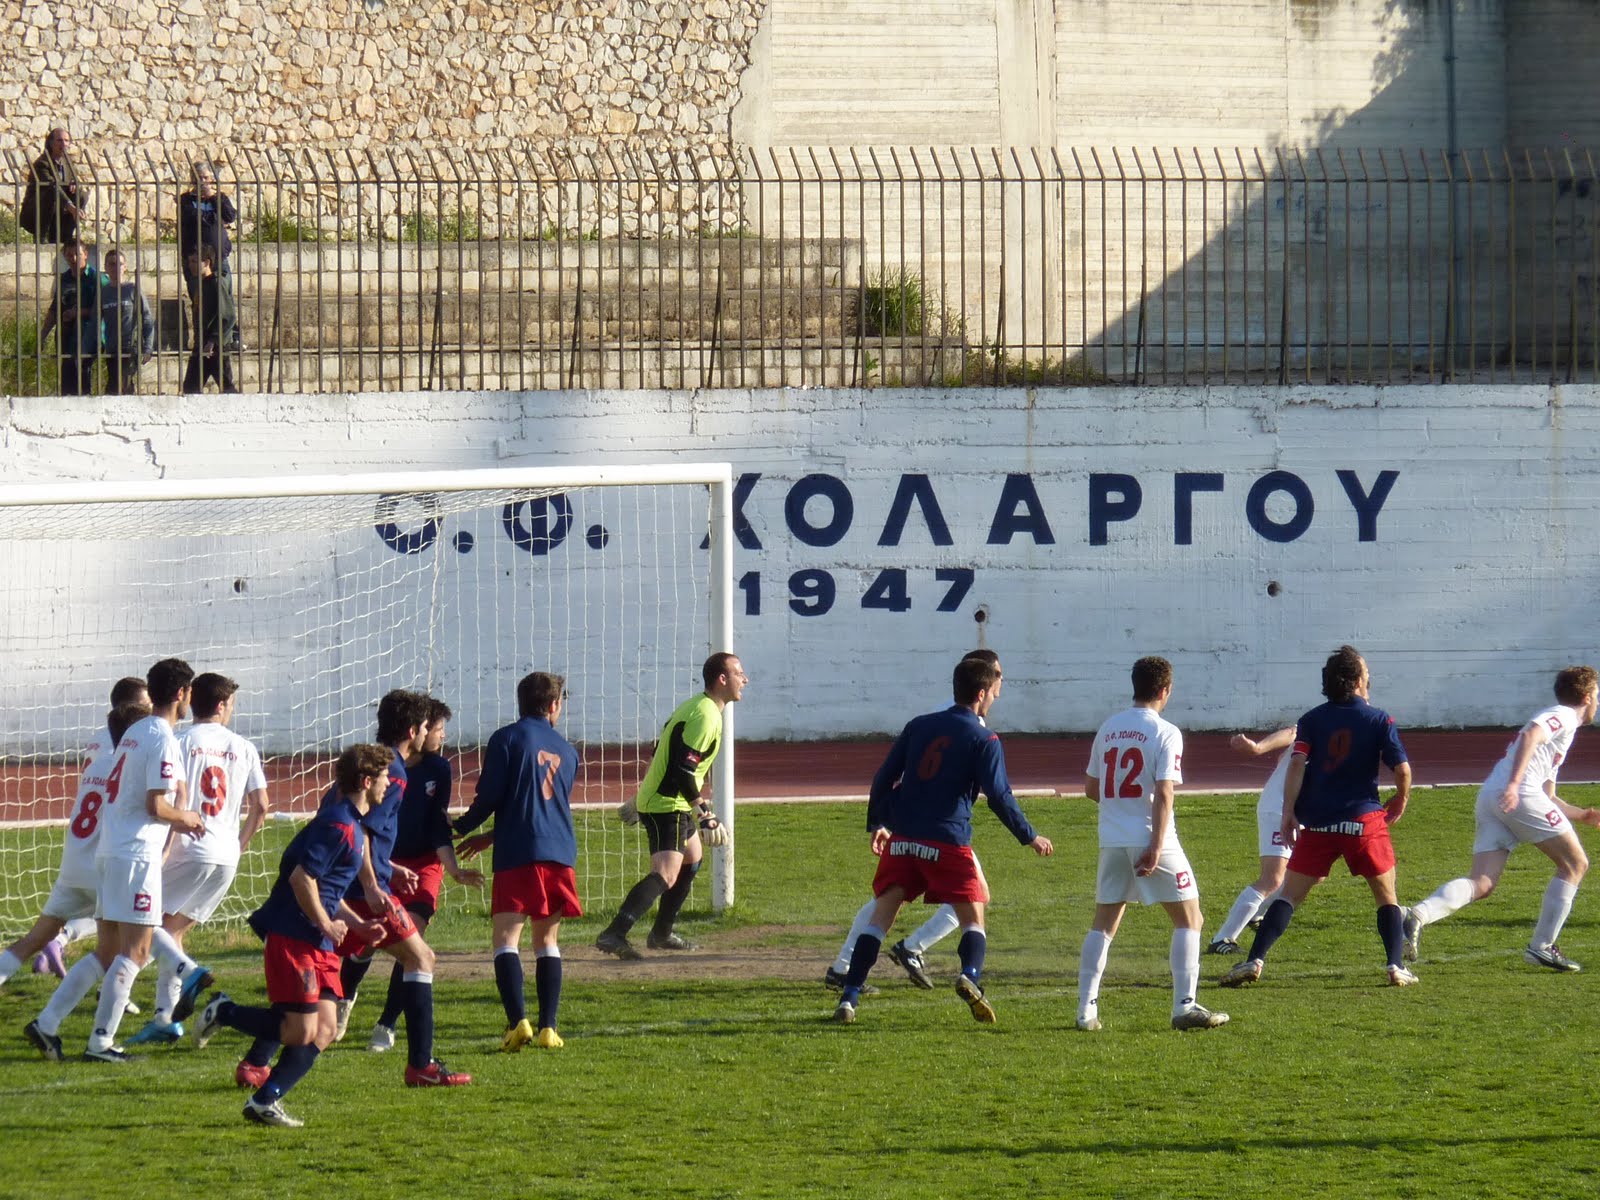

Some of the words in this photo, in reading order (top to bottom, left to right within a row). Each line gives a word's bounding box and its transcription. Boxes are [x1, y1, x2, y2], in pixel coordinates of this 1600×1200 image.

[739, 568, 975, 616] 1947
[537, 749, 561, 801] 7
[917, 735, 952, 781] 6
[1103, 746, 1144, 799] 12
[1325, 728, 1353, 773] 9
[105, 751, 127, 804] 4
[200, 765, 227, 817] 9
[71, 790, 103, 840] 8
